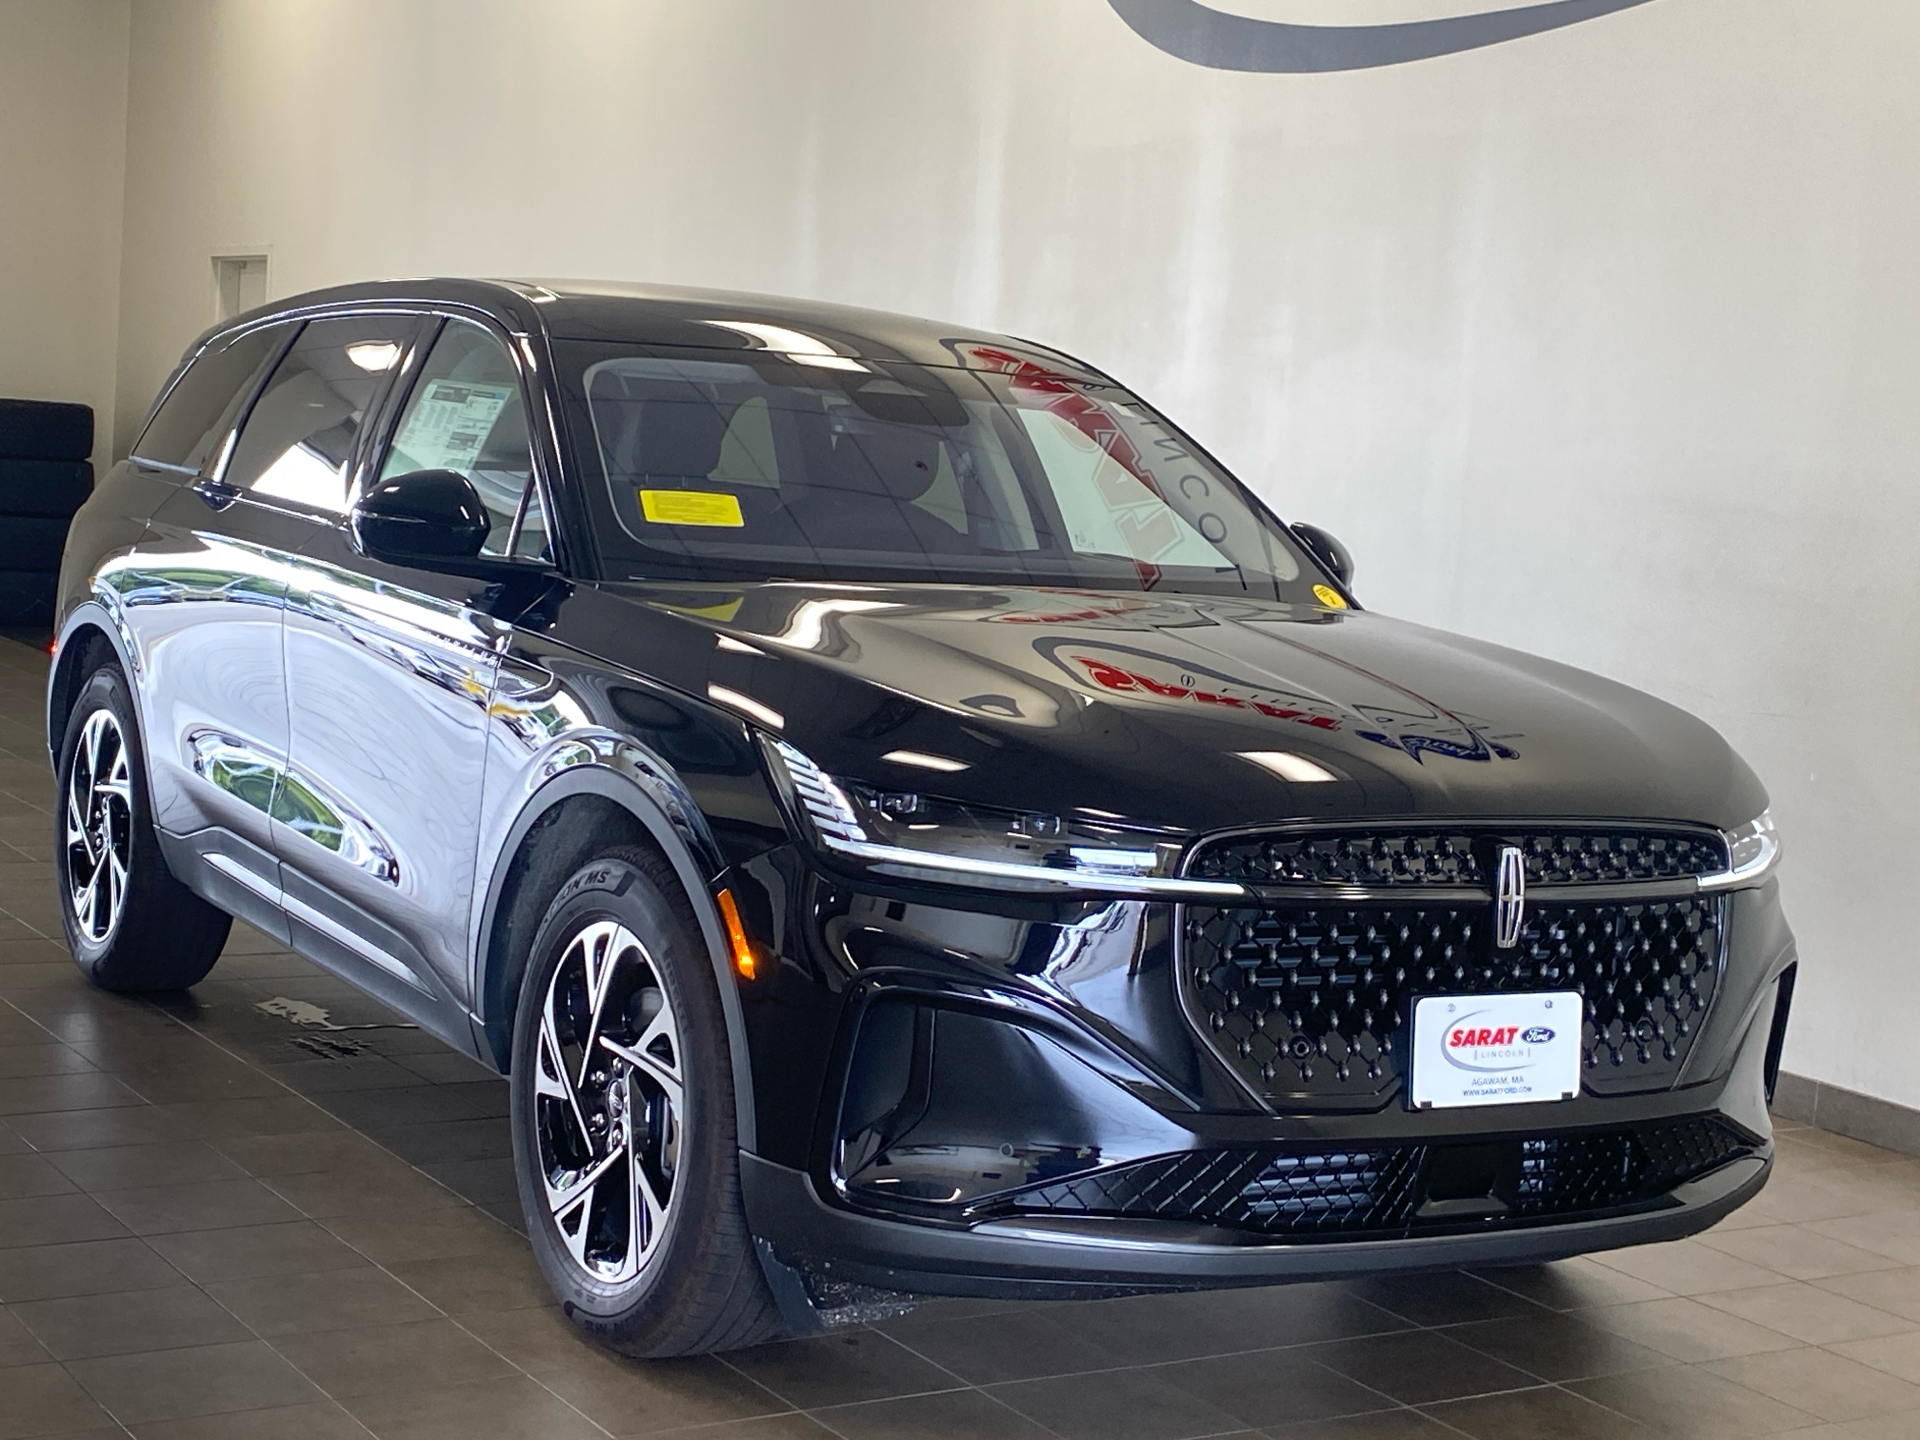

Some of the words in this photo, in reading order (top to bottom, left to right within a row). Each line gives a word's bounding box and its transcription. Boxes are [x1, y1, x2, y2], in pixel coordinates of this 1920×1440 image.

[584, 869, 610, 886] MS
[1450, 1026, 1519, 1047] SARAT
[1525, 1027, 1552, 1043] Ford
[1481, 1049, 1524, 1059] LINCOLN
[1512, 1076, 1525, 1084] MA
